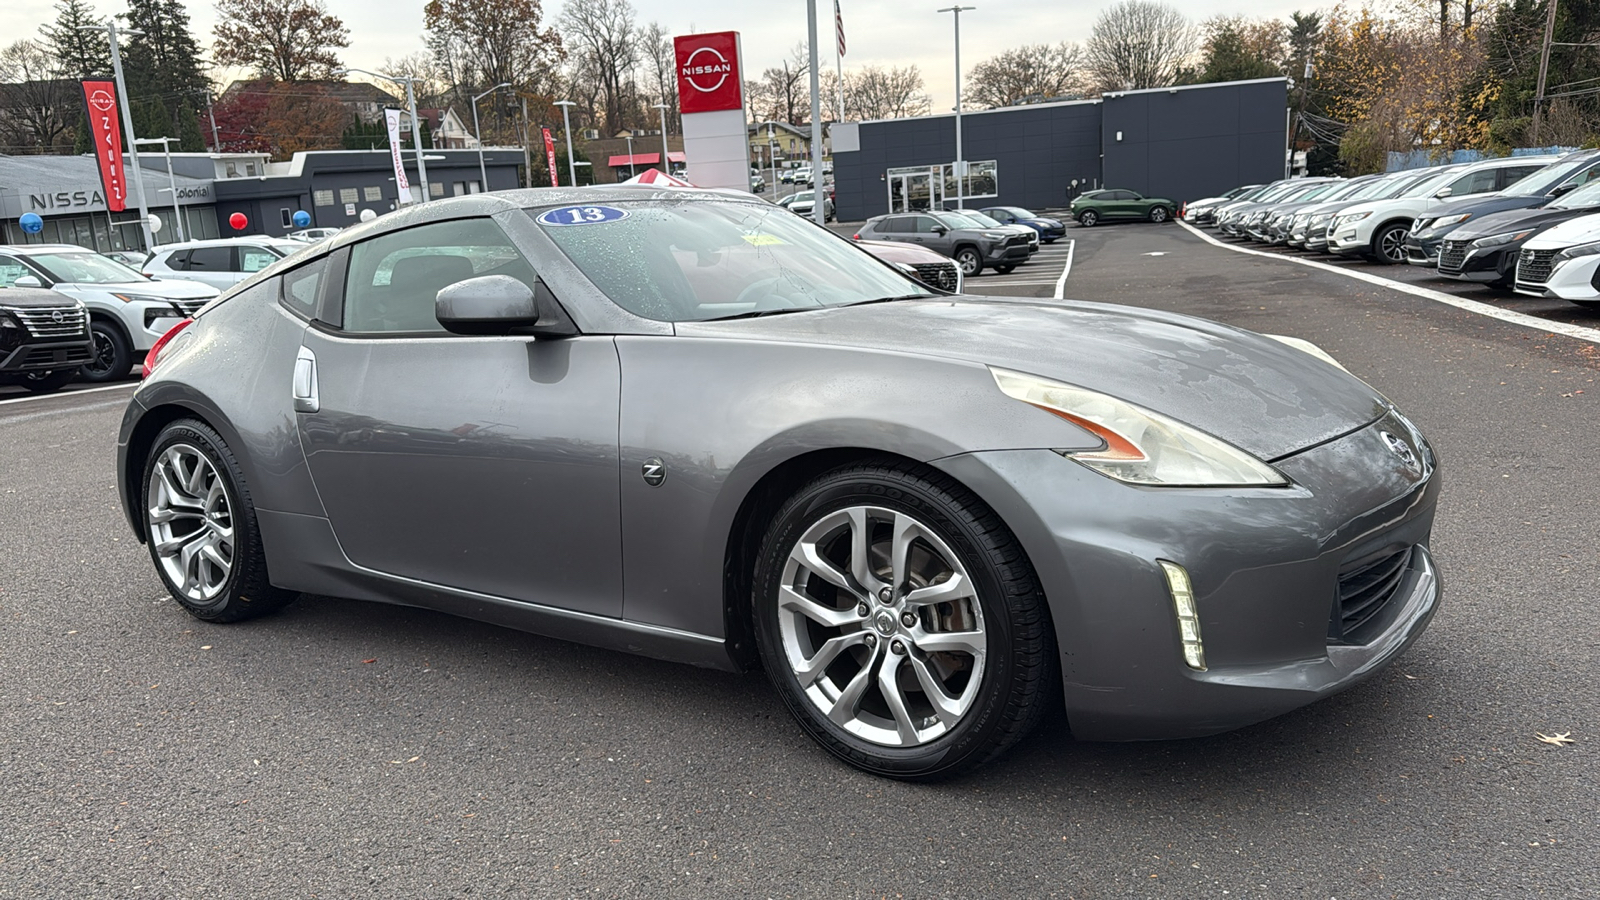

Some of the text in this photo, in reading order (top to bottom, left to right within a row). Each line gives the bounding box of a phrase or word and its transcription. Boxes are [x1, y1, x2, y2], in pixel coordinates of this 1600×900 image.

[682, 63, 731, 76] NISSAN
[102, 116, 122, 200] NISSAN
[29, 191, 105, 211] NISSA
[567, 207, 606, 224] 13
[643, 464, 662, 478] Z
[852, 482, 984, 570] GOODYEAR
